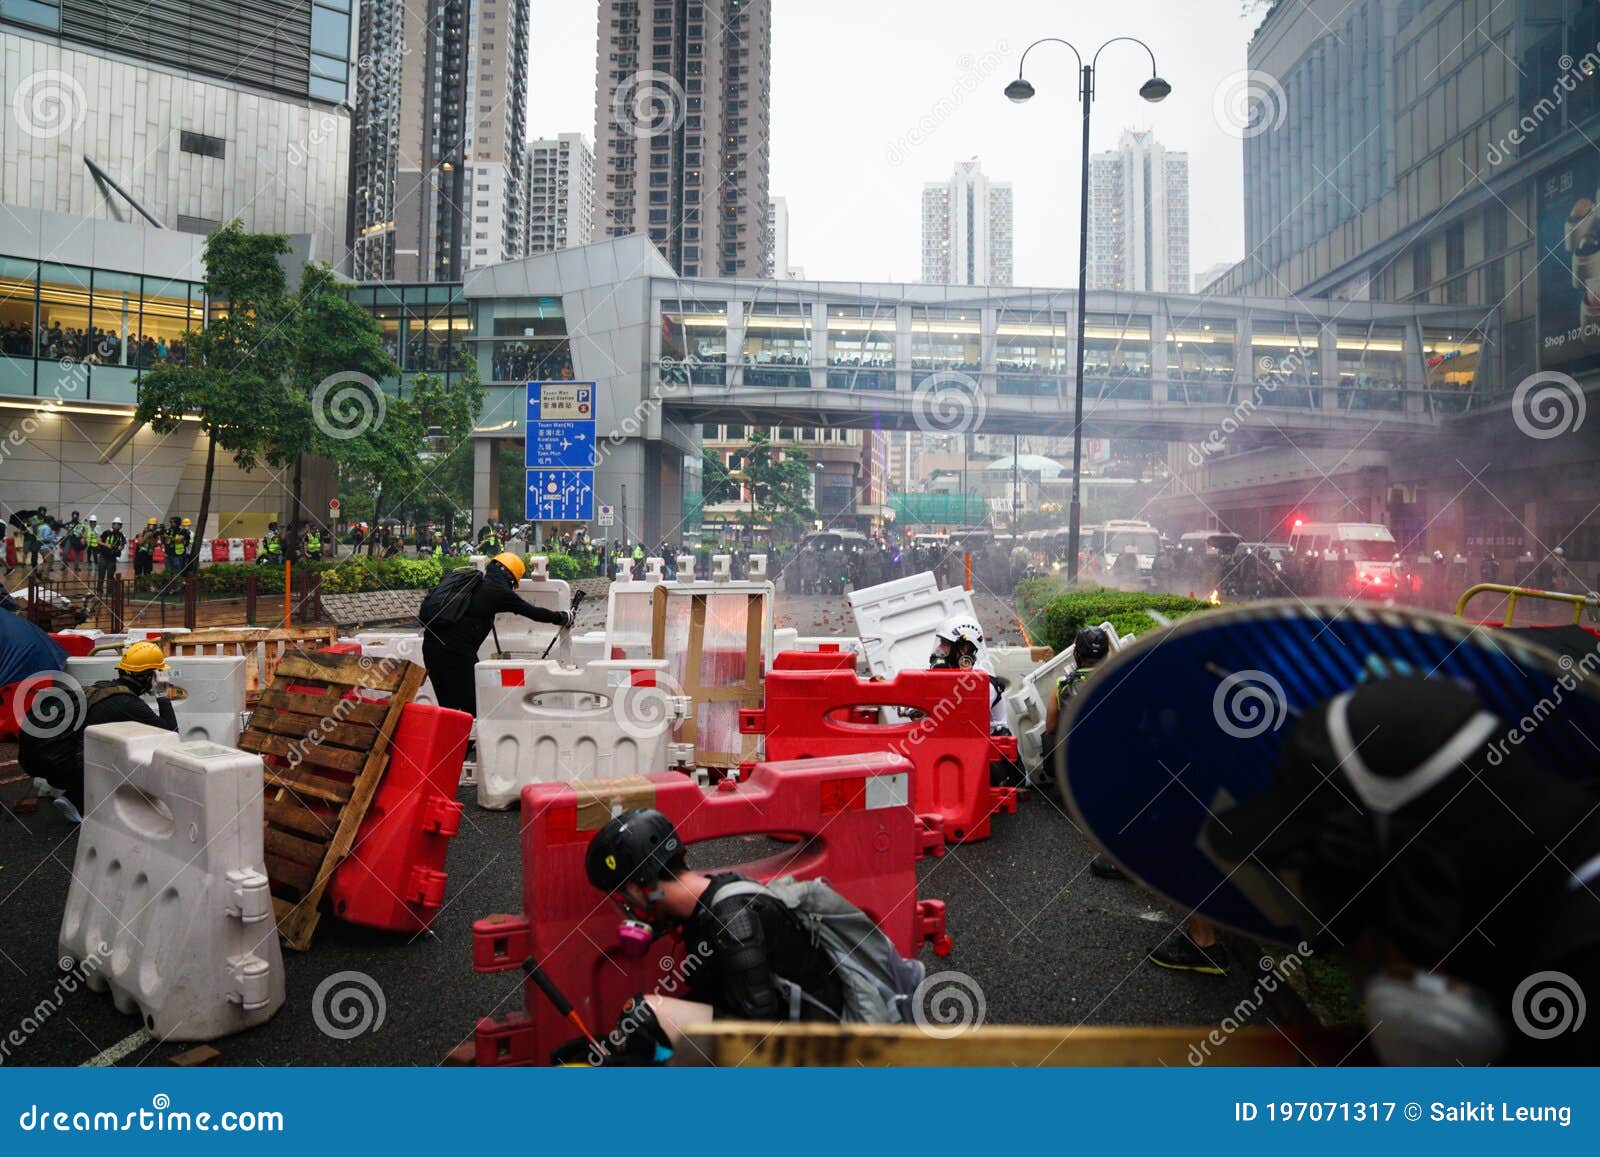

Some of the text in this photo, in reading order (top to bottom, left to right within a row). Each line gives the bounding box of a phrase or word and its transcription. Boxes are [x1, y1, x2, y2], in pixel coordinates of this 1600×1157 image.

[1544, 334, 1565, 348] Shop
[1568, 328, 1582, 342] 107
[579, 391, 588, 401] P
